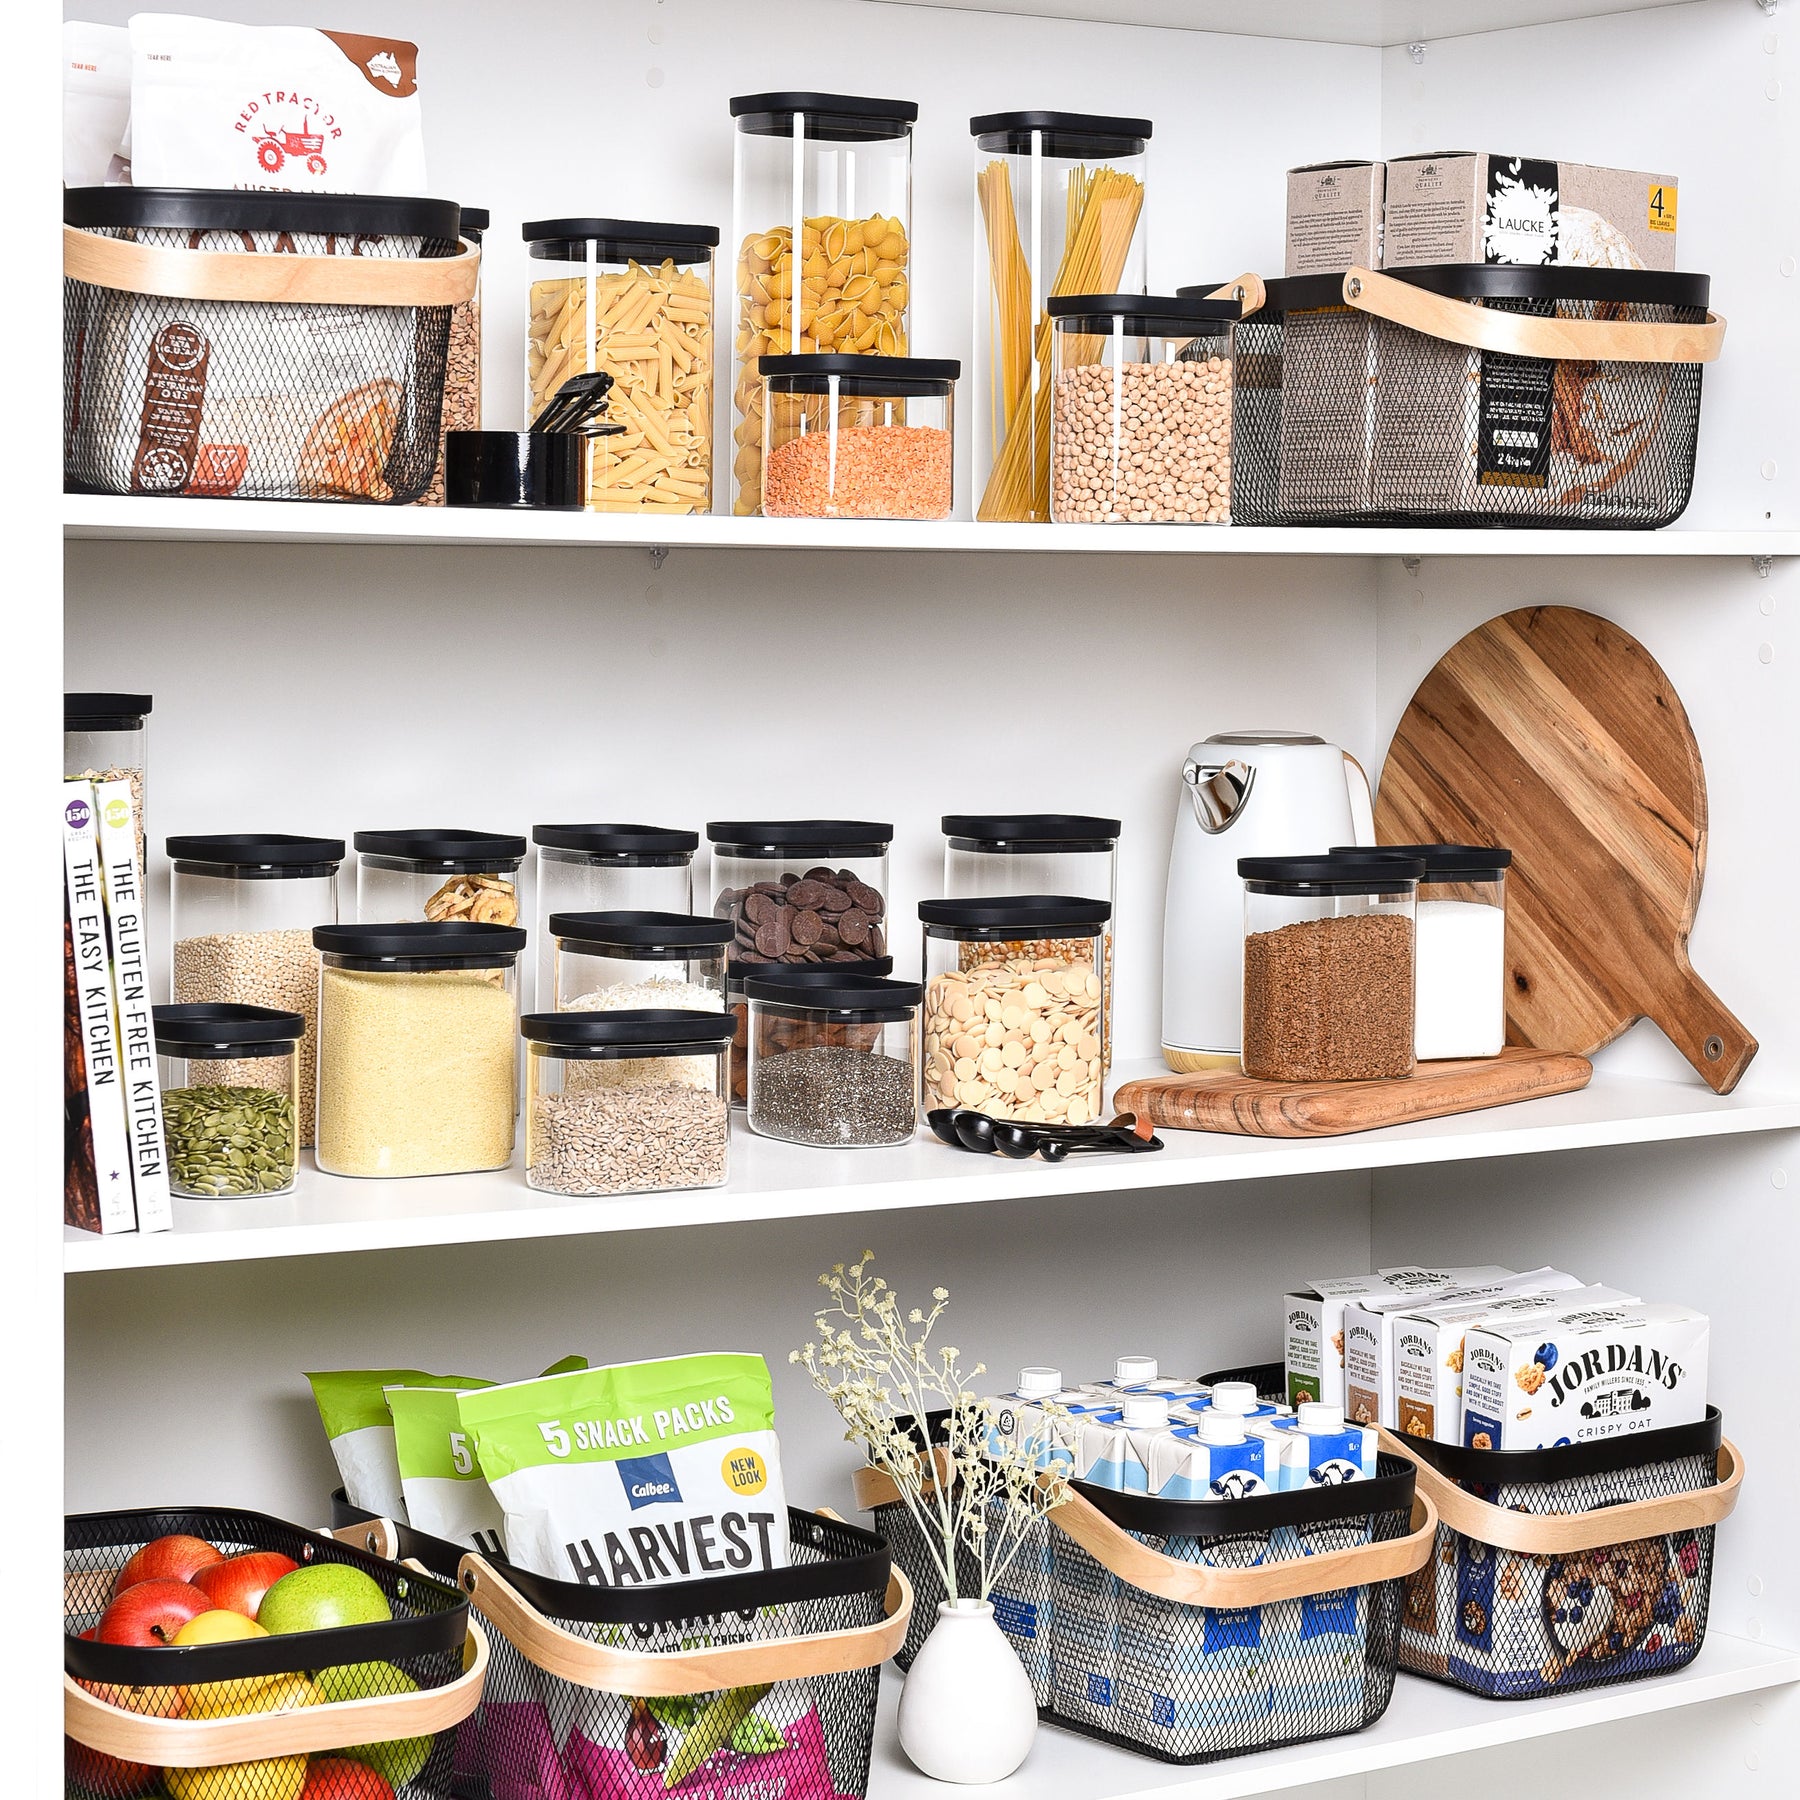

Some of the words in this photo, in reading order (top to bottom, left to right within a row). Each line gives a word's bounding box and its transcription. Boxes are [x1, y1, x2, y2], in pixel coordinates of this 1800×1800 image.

[234, 102, 259, 133] RED
[1650, 188, 1665, 218] 4
[1499, 217, 1544, 233] LAUCKE
[66, 808, 90, 821] 150
[106, 808, 129, 821] 150
[73, 859, 96, 903] THE
[113, 859, 135, 902] THE
[79, 915, 103, 972] EASY
[118, 914, 151, 1070] GLUTEN-FREE
[86, 987, 115, 1085] KITCHEN
[133, 1080, 161, 1177] KITCHEN
[1288, 1310, 1318, 1329] JORDANS
[1350, 1327, 1376, 1346] JORDANS
[1400, 1335, 1431, 1354] JORDANS
[1470, 1349, 1503, 1371] JORDANS
[1470, 1374, 1486, 1384] BASICALLY
[1493, 1382, 1502, 1390] TAKE
[1548, 1344, 1683, 1408] JORDANS
[1584, 1382, 1600, 1394] FAMILY
[1601, 1376, 1620, 1386] MILLERS
[1622, 1376, 1634, 1384] SINCE
[1483, 1394, 1492, 1403] MESS
[1493, 1398, 1504, 1407] ABOUT
[1491, 1389, 1502, 1397] STUFF
[537, 1420, 571, 1458] 5
[573, 1415, 650, 1450] SNACK
[653, 1396, 735, 1439] PACKS
[1577, 1423, 1622, 1438] CRISPY
[1629, 1418, 1652, 1430] OAT
[449, 1432, 473, 1475] 5
[730, 1457, 755, 1473] NEW
[732, 1470, 762, 1487] LOOK
[631, 1482, 670, 1497] Calbee
[566, 1512, 775, 1587] HARVEST
[713, 1633, 752, 1647] CRISPS
